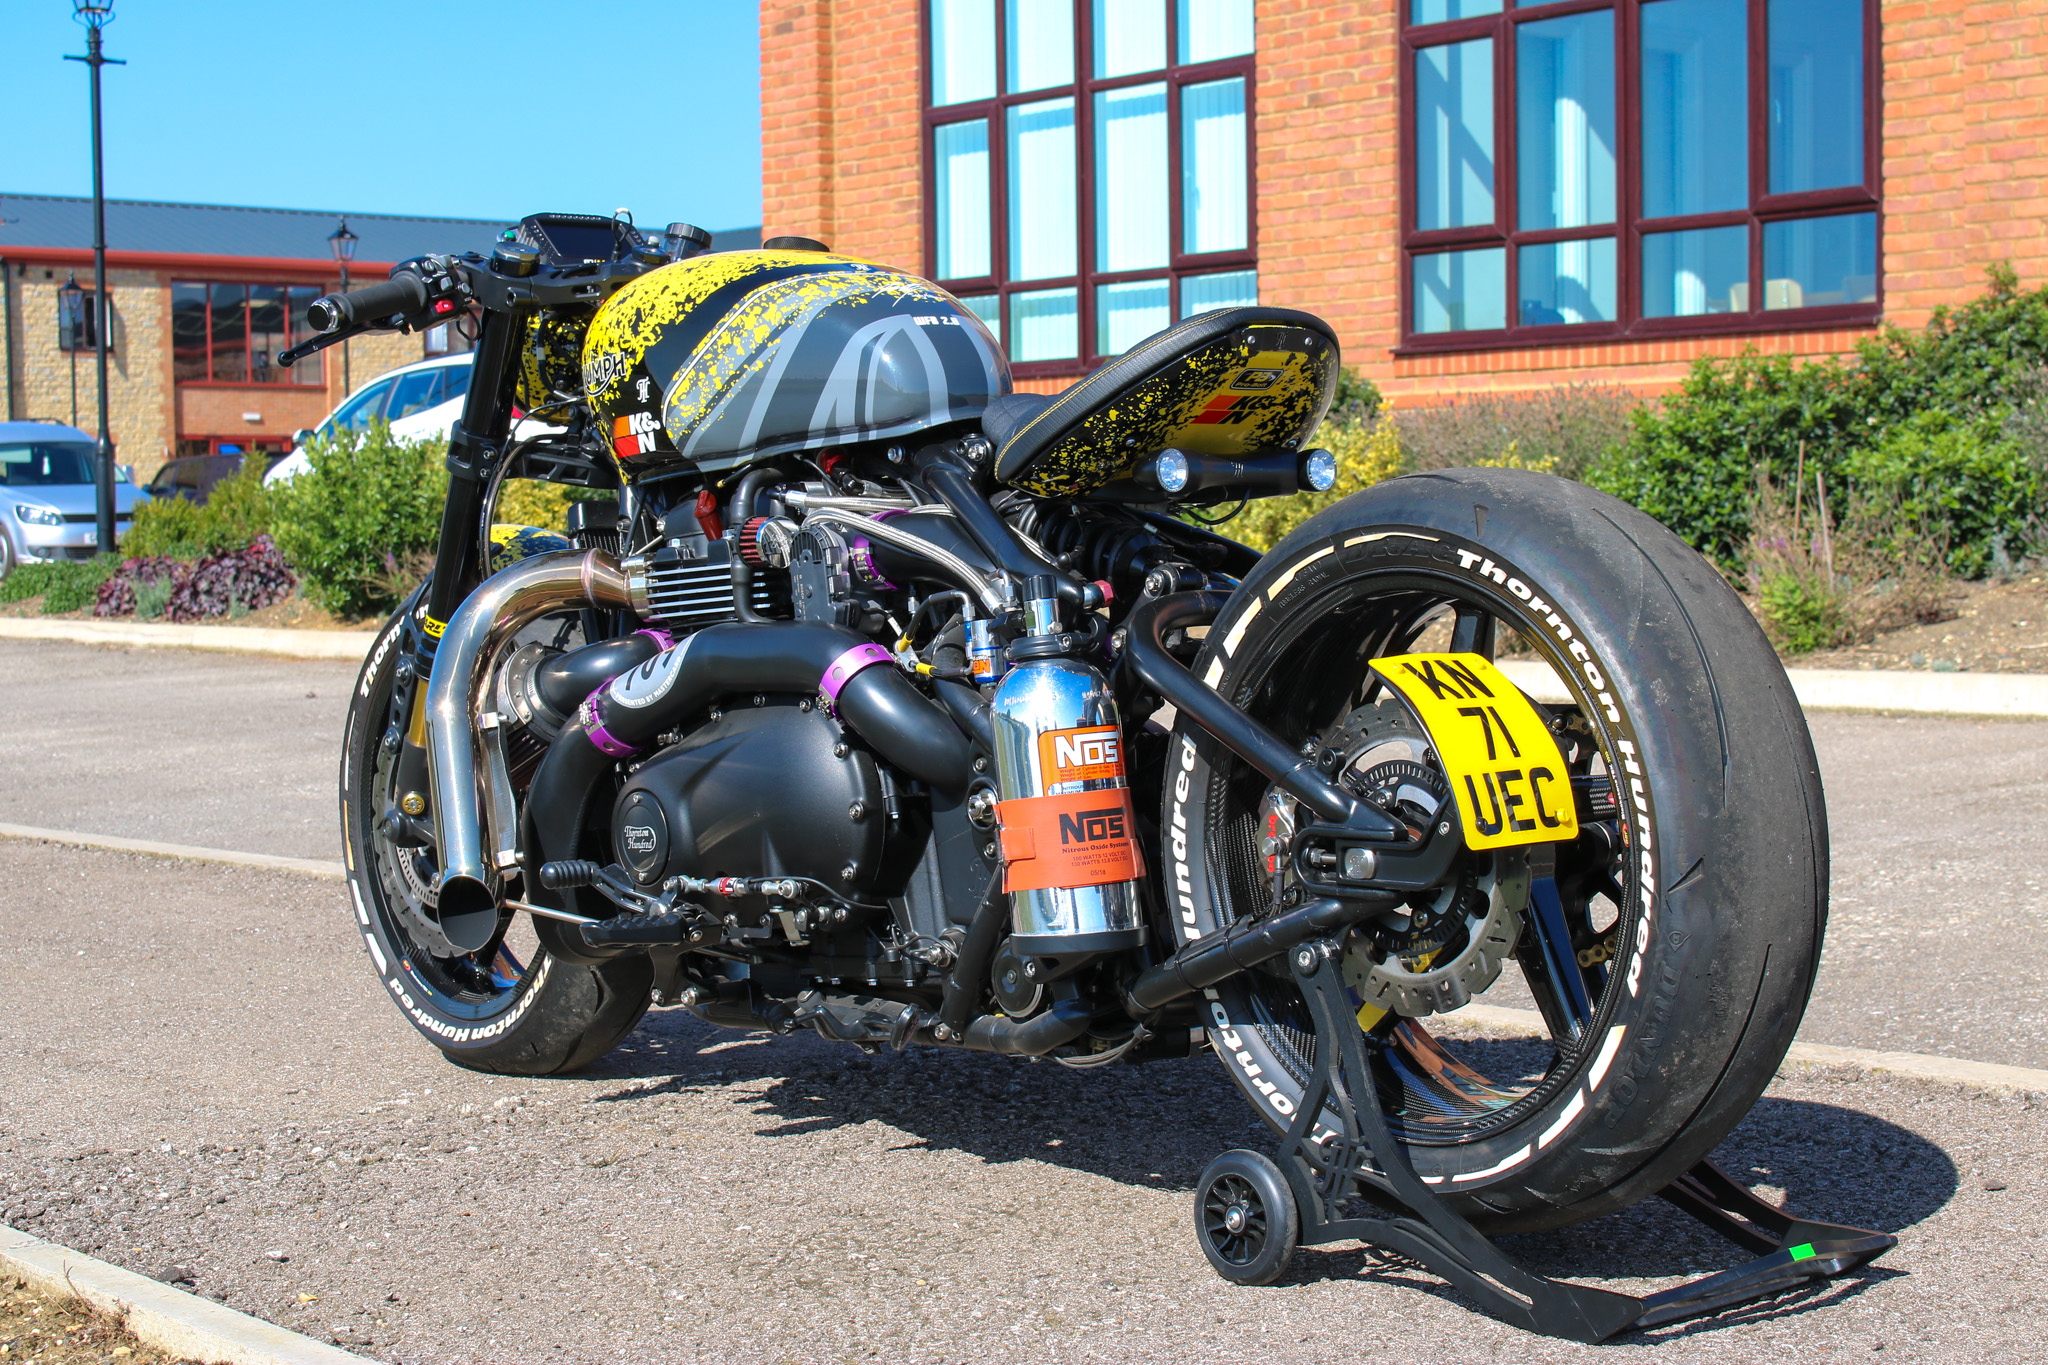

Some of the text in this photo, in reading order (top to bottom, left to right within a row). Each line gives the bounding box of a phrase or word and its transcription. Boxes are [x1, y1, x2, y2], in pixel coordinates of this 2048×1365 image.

[615, 691, 647, 706] PRESENTED
[653, 655, 682, 699] MASTERCARD
[1402, 659, 1496, 700] KN
[1054, 729, 1120, 769] NOS
[1457, 706, 1522, 760] 71
[1457, 548, 1656, 998] Thornton Hundred
[1059, 807, 1126, 845] NOS
[1464, 766, 1561, 837] UEC
[1062, 846, 1090, 854] Nitrous
[1090, 843, 1109, 851] Oxide
[388, 954, 553, 1042] Thornton Hundred
